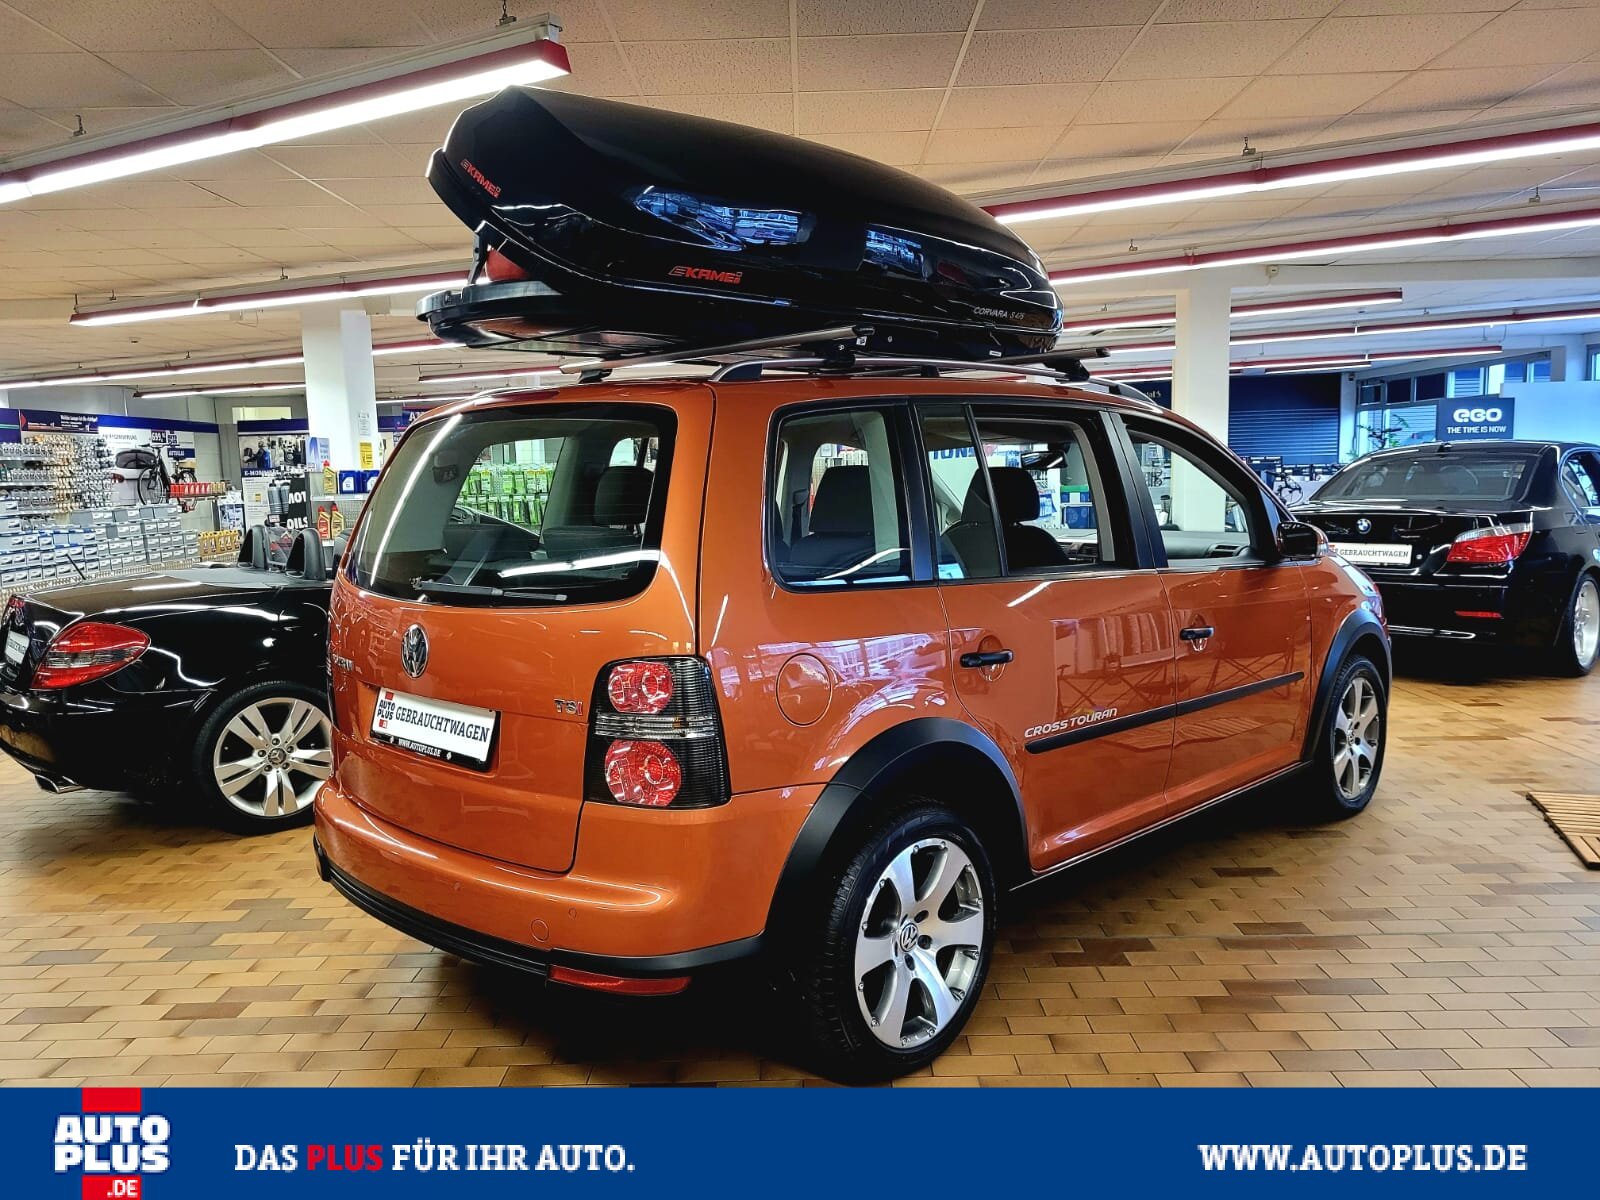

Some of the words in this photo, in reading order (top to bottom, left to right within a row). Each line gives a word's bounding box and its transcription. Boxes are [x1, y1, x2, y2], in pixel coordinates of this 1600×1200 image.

[1447, 426, 1462, 434] THE
[1463, 426, 1481, 434] TIME
[1488, 425, 1507, 433] NOW
[1339, 548, 1409, 558] GEBRAUCHTWAGEN
[376, 708, 394, 721] PLUS
[395, 706, 491, 743] GEBRAUCHTWAGEN
[1024, 719, 1069, 738] CROSS
[1069, 707, 1118, 727] TOURAN
